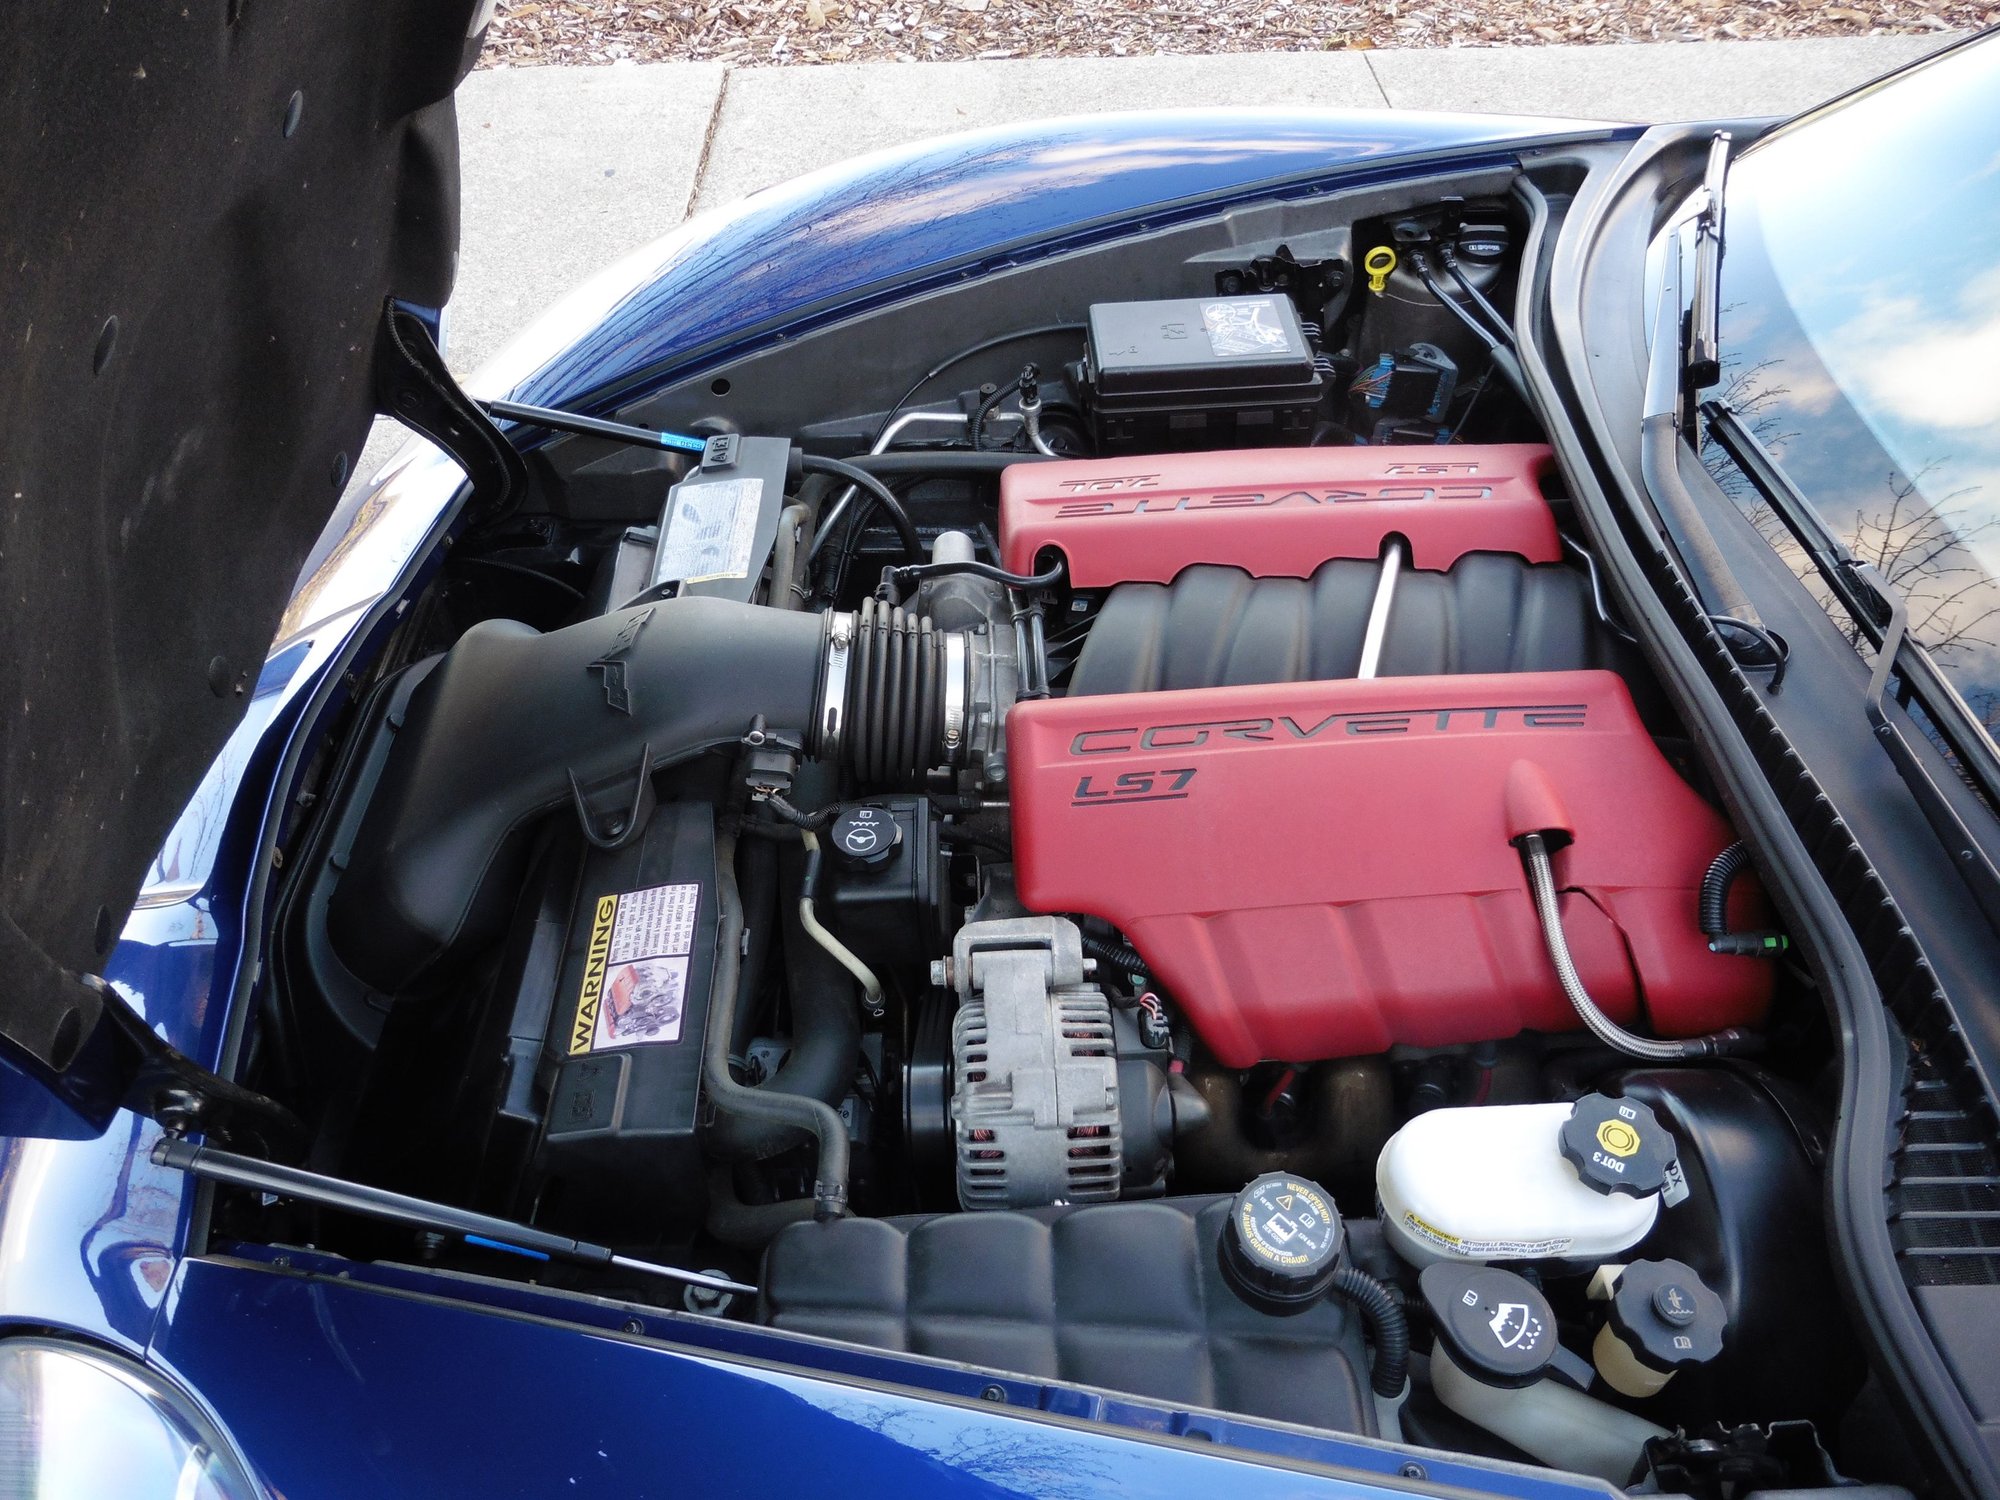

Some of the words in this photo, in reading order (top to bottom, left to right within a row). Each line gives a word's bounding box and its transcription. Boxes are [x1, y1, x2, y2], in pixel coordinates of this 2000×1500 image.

[1384, 462, 1480, 476] LS7
[1054, 486, 1492, 519] CORVETTE
[1069, 703, 1588, 756] CORVETTE
[1072, 767, 1197, 799] LS7
[573, 899, 614, 1051] WARNING
[1592, 1151, 1602, 1162] 3
[1600, 1155, 1625, 1173] DOT
[1287, 1183, 1309, 1195] NEVER
[1308, 1193, 1324, 1210] OPEN
[1250, 1237, 1274, 1259] OUVRIR
